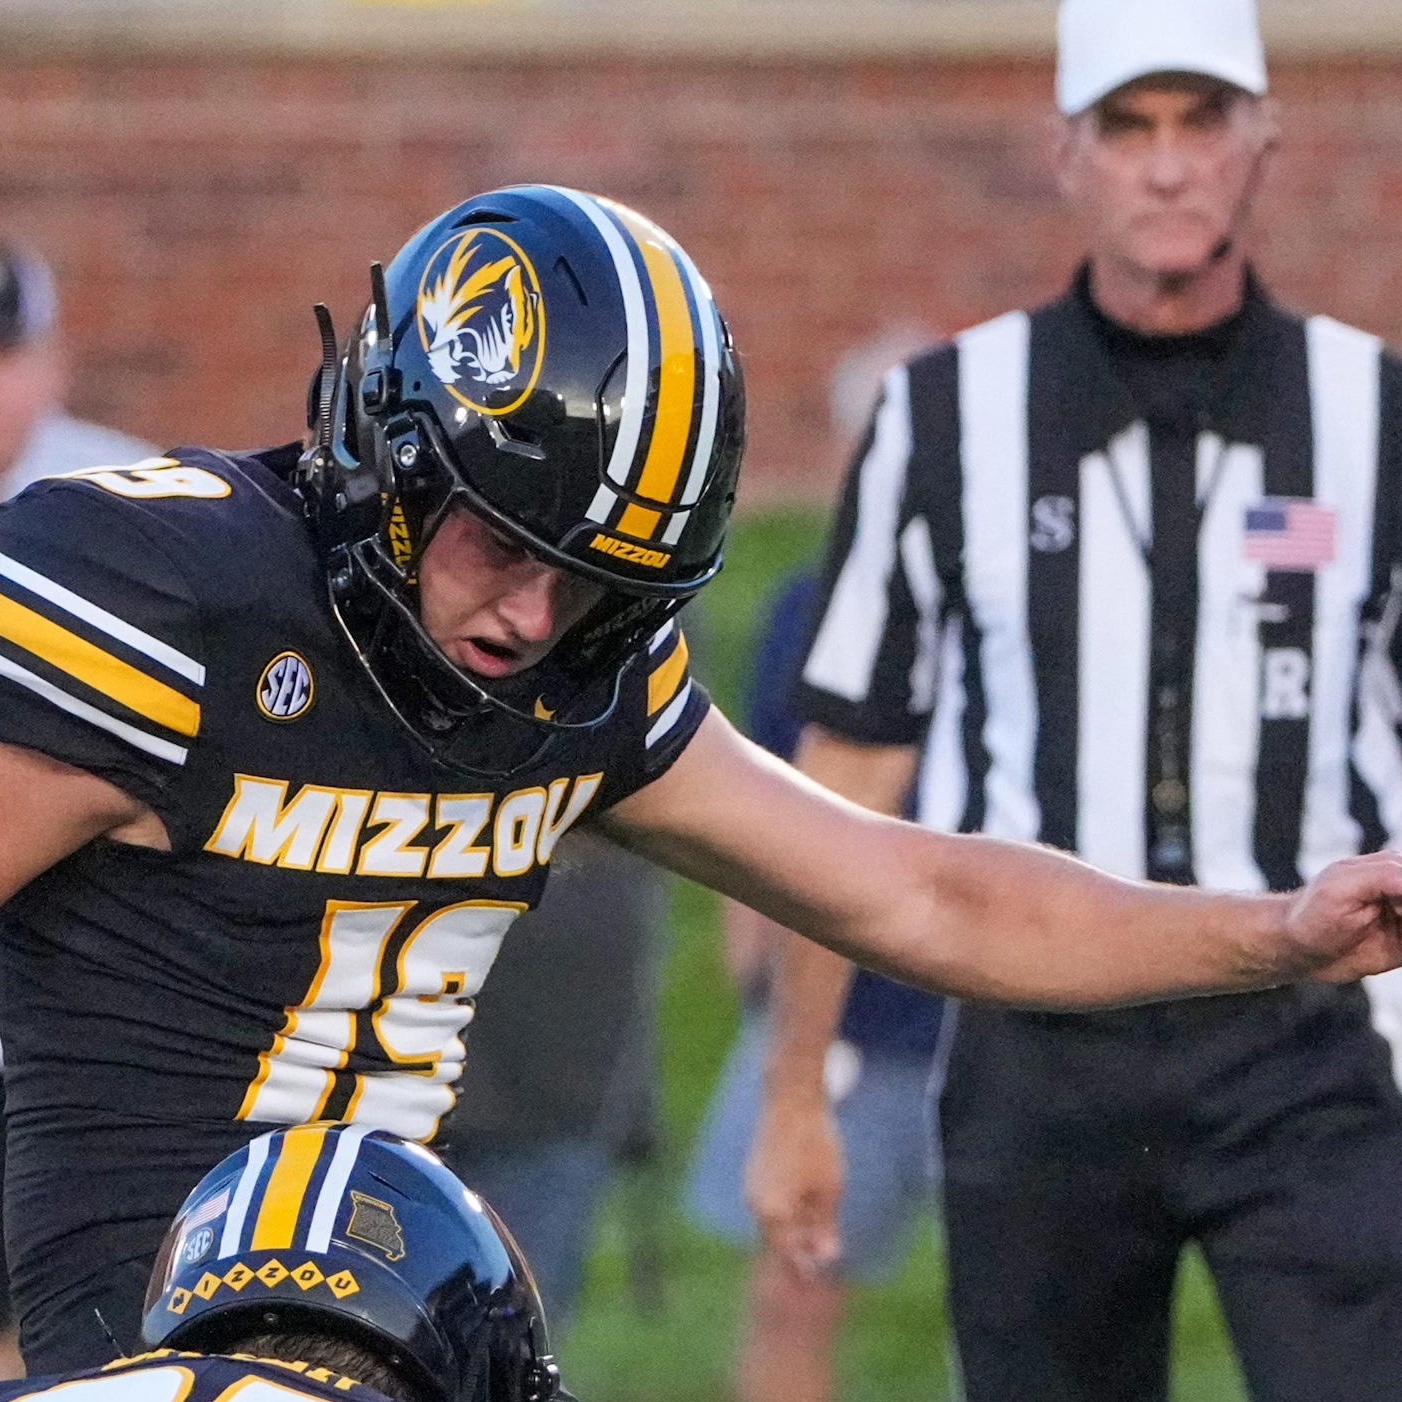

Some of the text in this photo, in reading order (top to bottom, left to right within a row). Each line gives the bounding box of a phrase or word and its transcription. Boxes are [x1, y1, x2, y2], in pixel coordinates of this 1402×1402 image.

[589, 533, 672, 569] MIZZOU
[1030, 495, 1076, 552] S
[261, 656, 309, 716] SEC
[1260, 646, 1309, 720] R
[204, 772, 604, 879] MIZZOU
[235, 898, 530, 1144] 19
[186, 1229, 211, 1261] SEC
